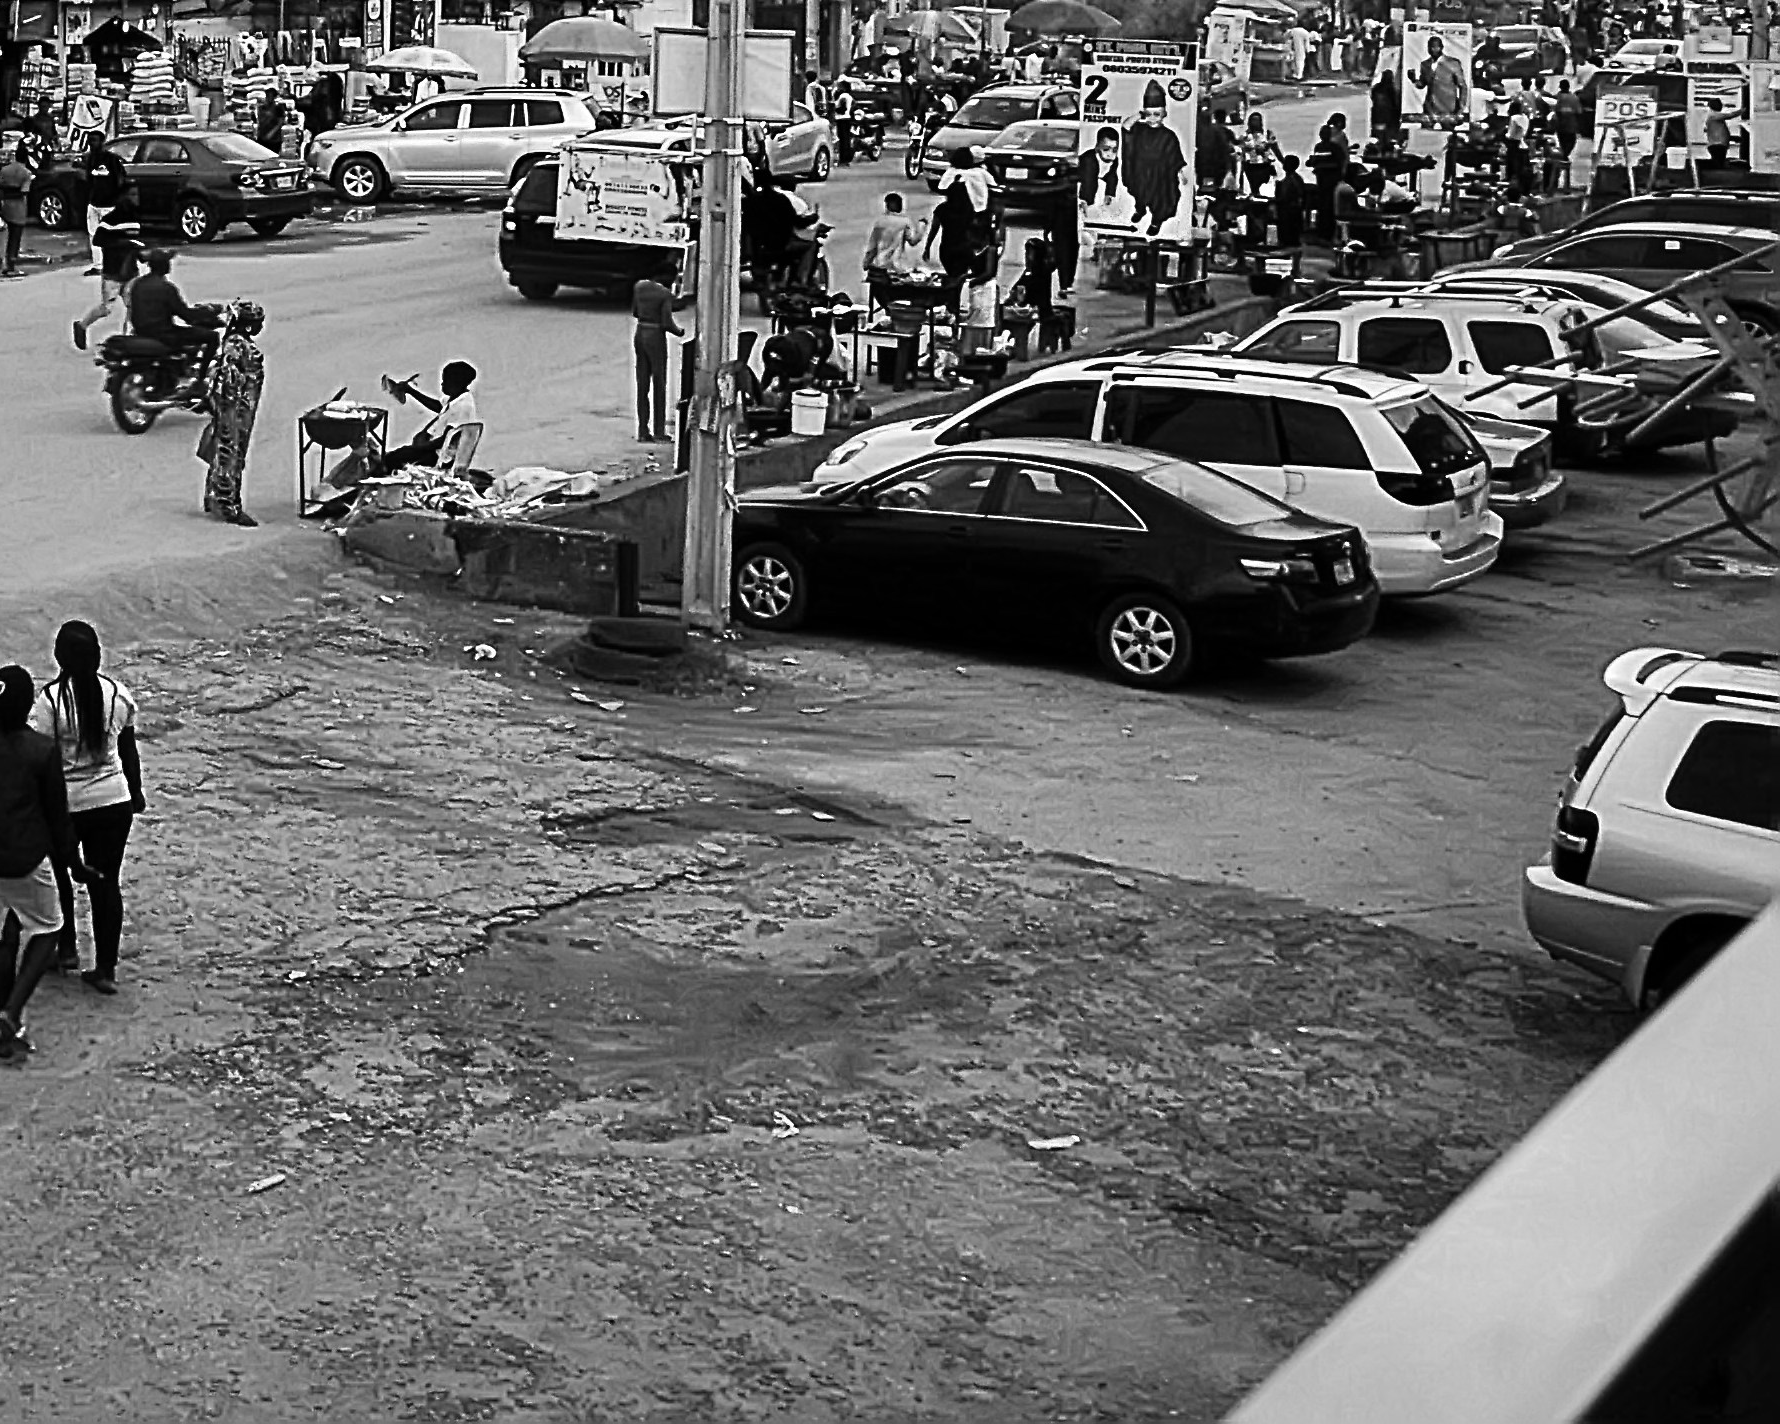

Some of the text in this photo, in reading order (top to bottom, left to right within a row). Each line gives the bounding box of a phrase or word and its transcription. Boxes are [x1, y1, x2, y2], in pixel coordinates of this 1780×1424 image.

[1084, 75, 1109, 105] 2
[1604, 102, 1648, 117] POS
[70, 127, 90, 153] PO
